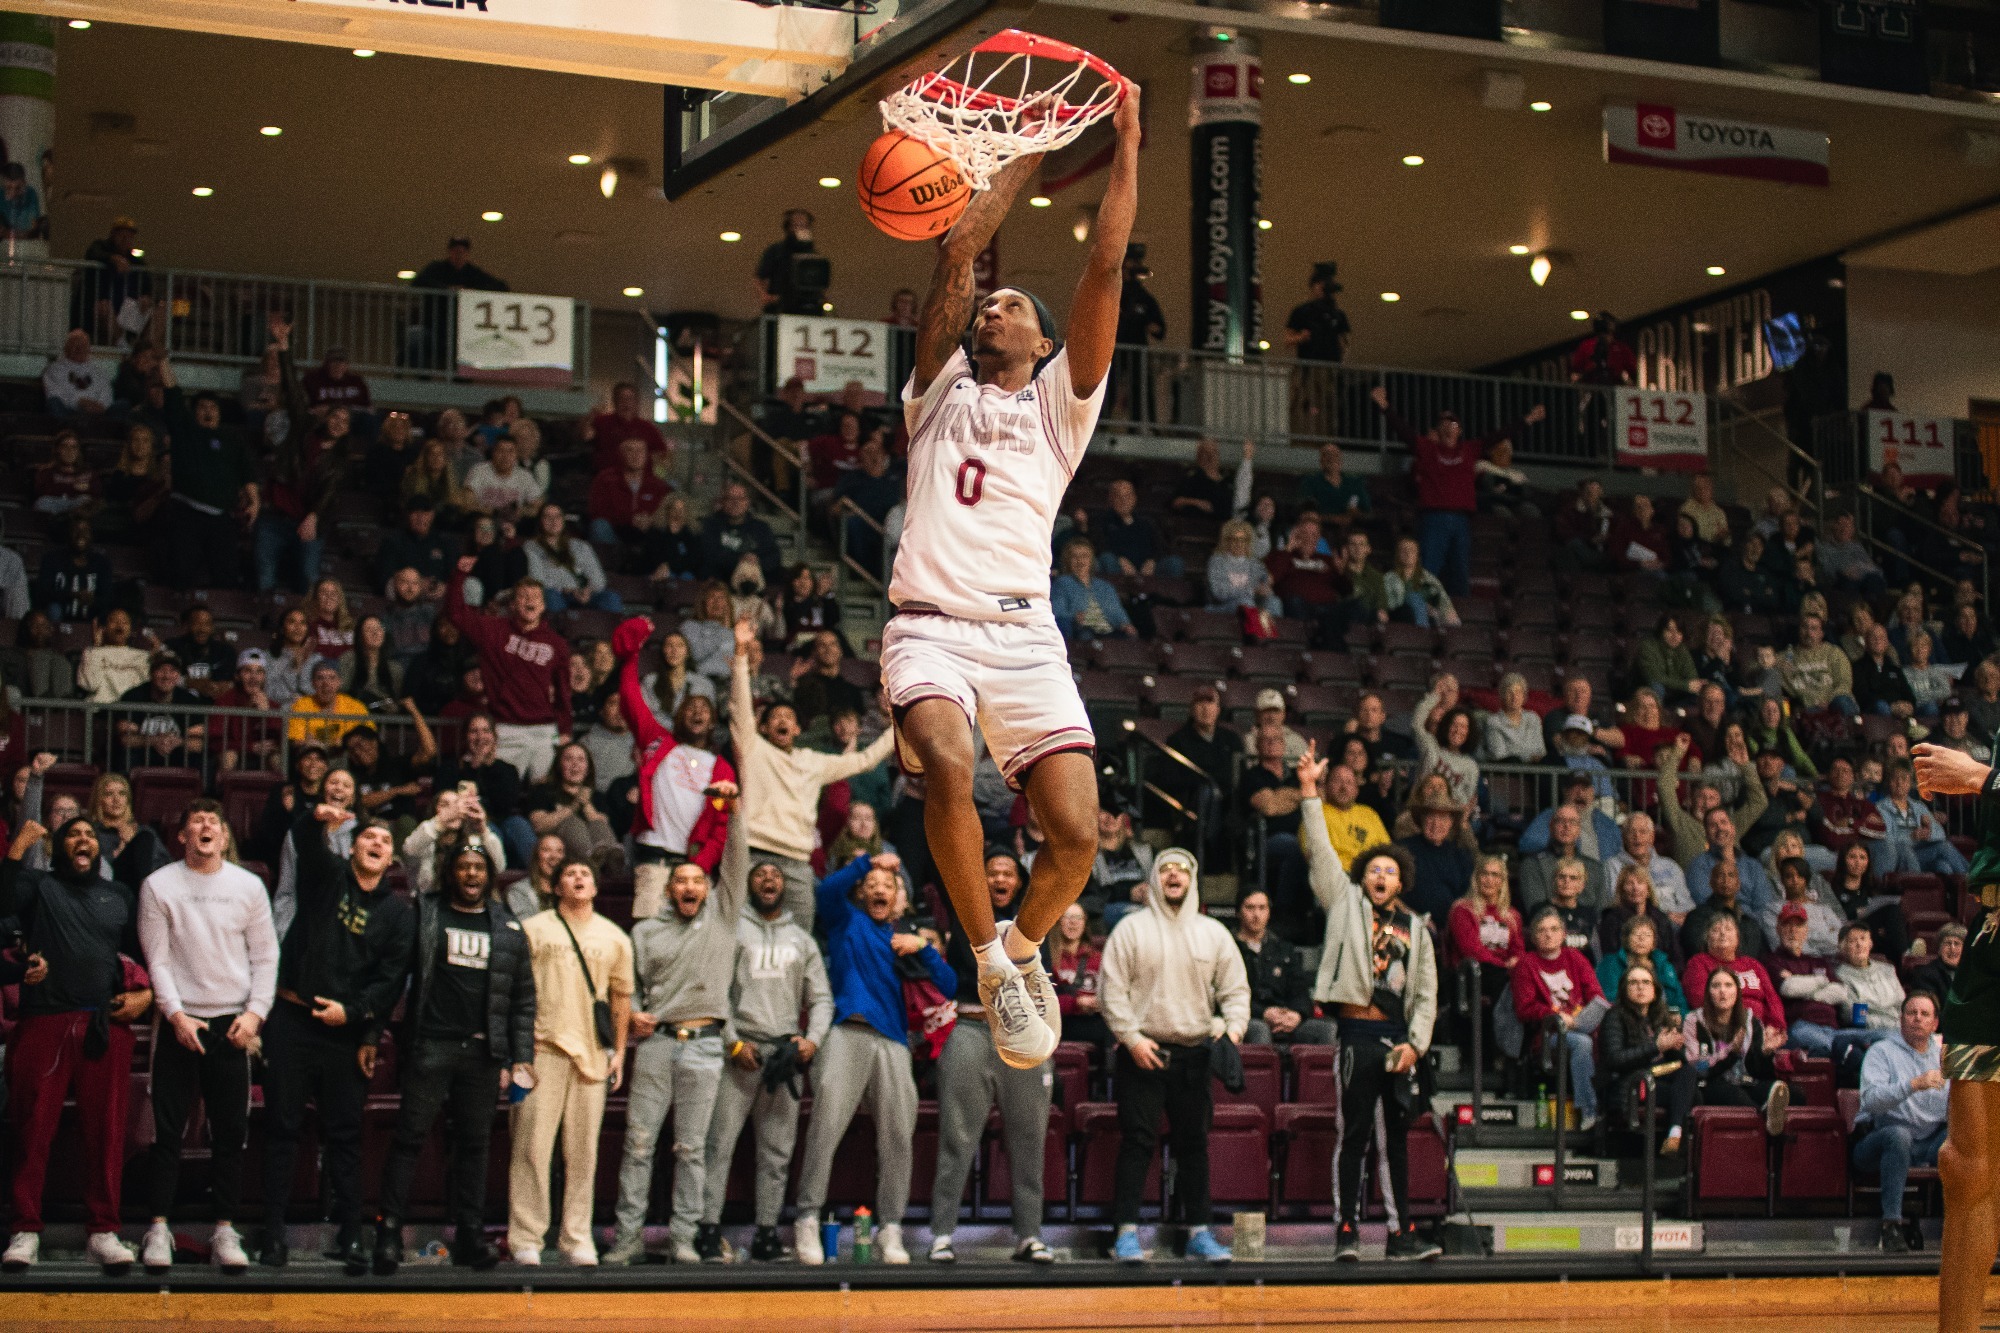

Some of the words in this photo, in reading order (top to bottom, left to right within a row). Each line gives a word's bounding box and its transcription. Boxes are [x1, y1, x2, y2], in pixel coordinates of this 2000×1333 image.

[1685, 119, 1775, 150] TOYOTA
[1205, 135, 1233, 284] toyota.com
[474, 300, 555, 346] 113
[793, 324, 875, 359] 112
[1205, 299, 1233, 349] buy
[1637, 287, 1774, 391] CRAFTED
[934, 403, 1037, 456] HAWKS
[1626, 396, 1696, 426] 112
[1880, 418, 1944, 449] 111
[954, 456, 987, 508] 0
[504, 634, 554, 666] IUP
[1481, 1108, 1514, 1121] OYOTA
